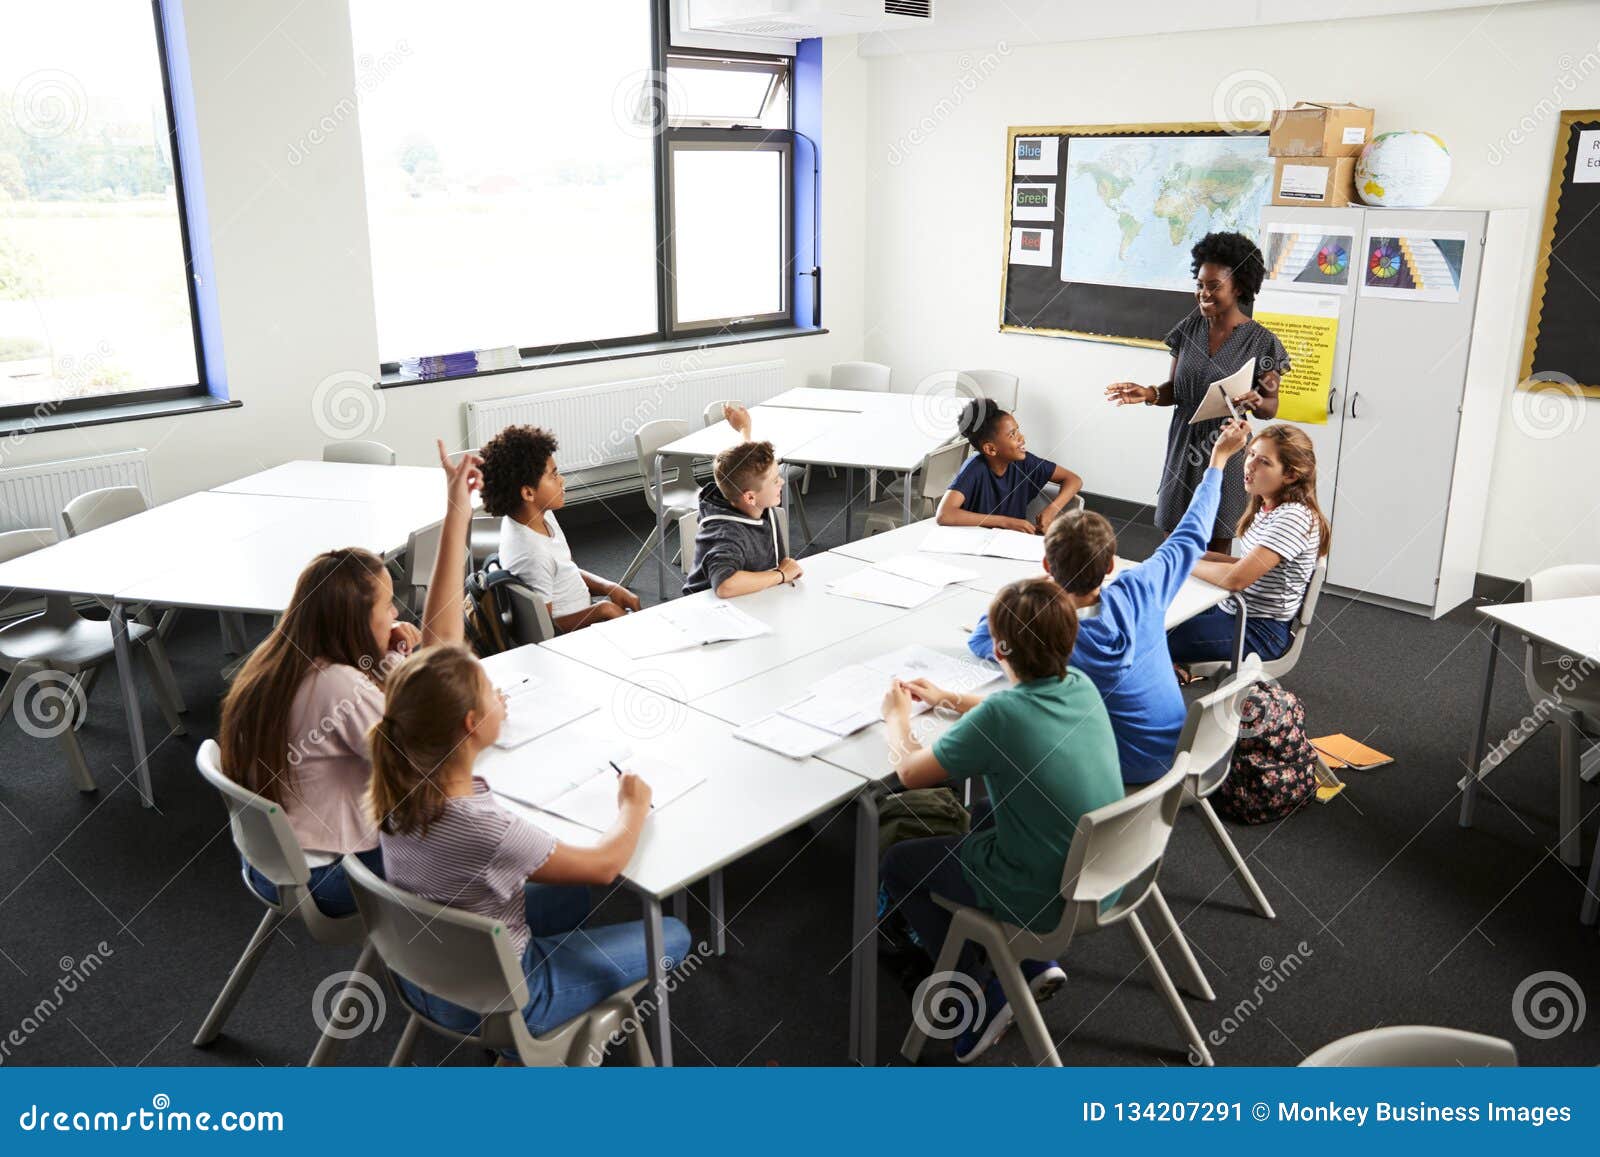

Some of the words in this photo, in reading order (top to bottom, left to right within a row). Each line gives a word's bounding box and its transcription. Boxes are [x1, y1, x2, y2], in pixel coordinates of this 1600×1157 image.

[1018, 144, 1041, 157] Blue
[1017, 191, 1048, 204] Green
[1022, 235, 1041, 248] Red
